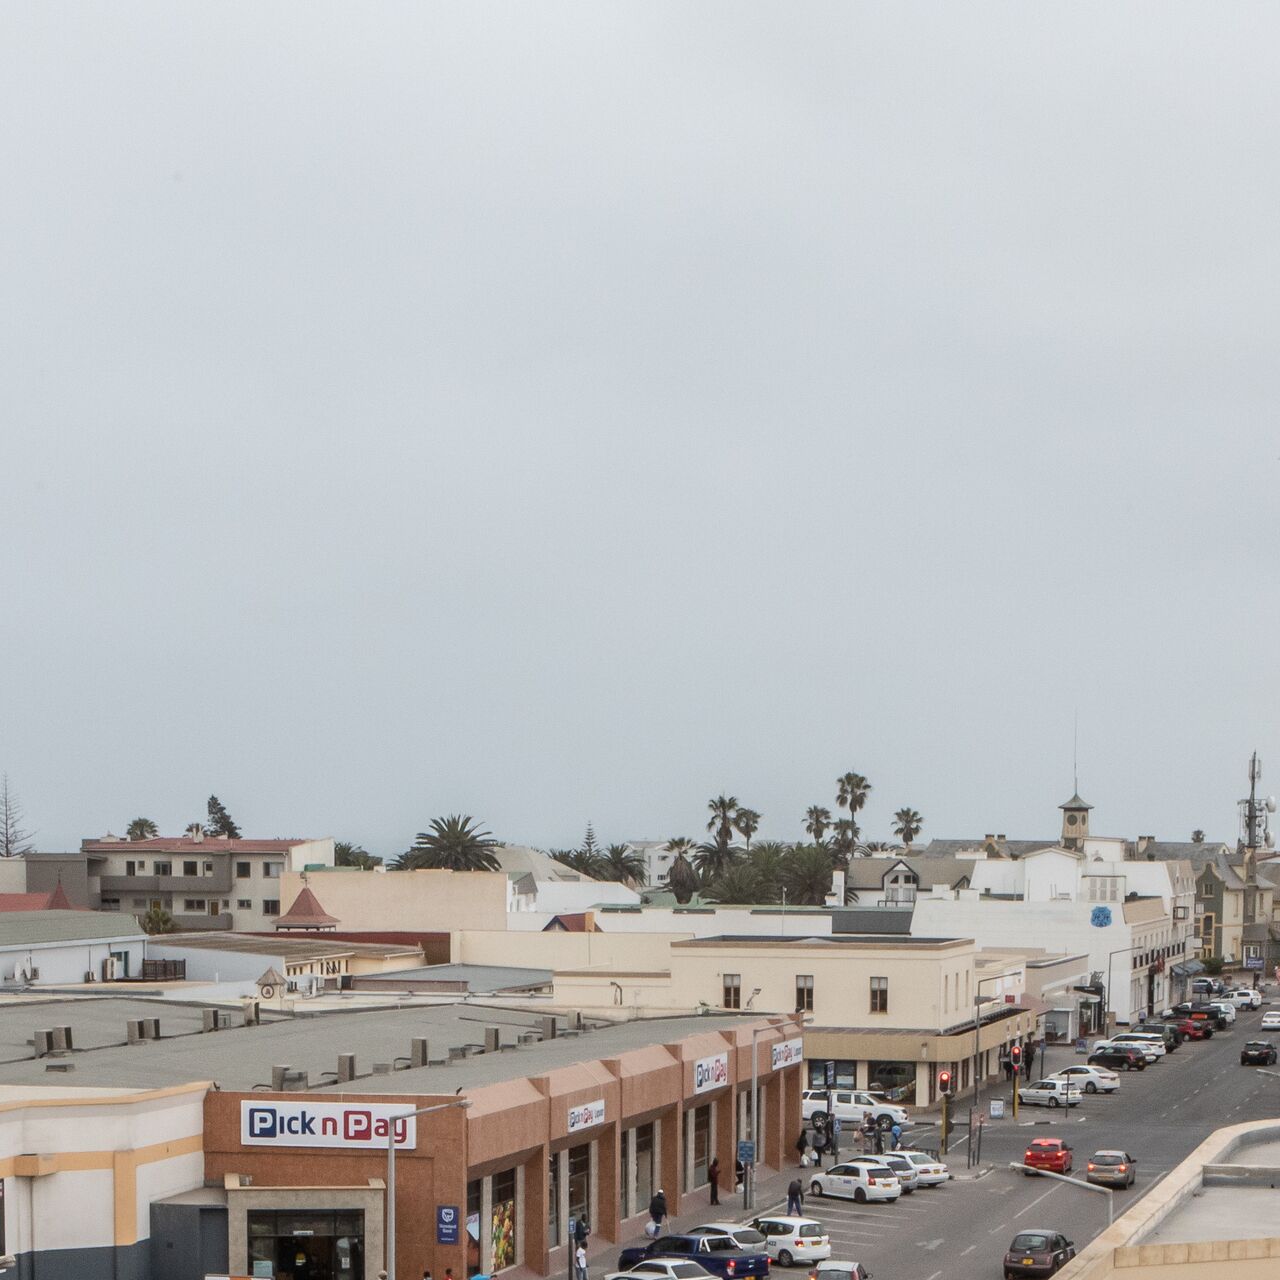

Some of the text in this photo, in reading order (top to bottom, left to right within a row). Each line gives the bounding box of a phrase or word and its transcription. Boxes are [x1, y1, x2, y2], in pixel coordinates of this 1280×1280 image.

[697, 1063, 710, 1088] Pick
[715, 1058, 727, 1083] Pay
[249, 1108, 407, 1143] Pick n Pay
